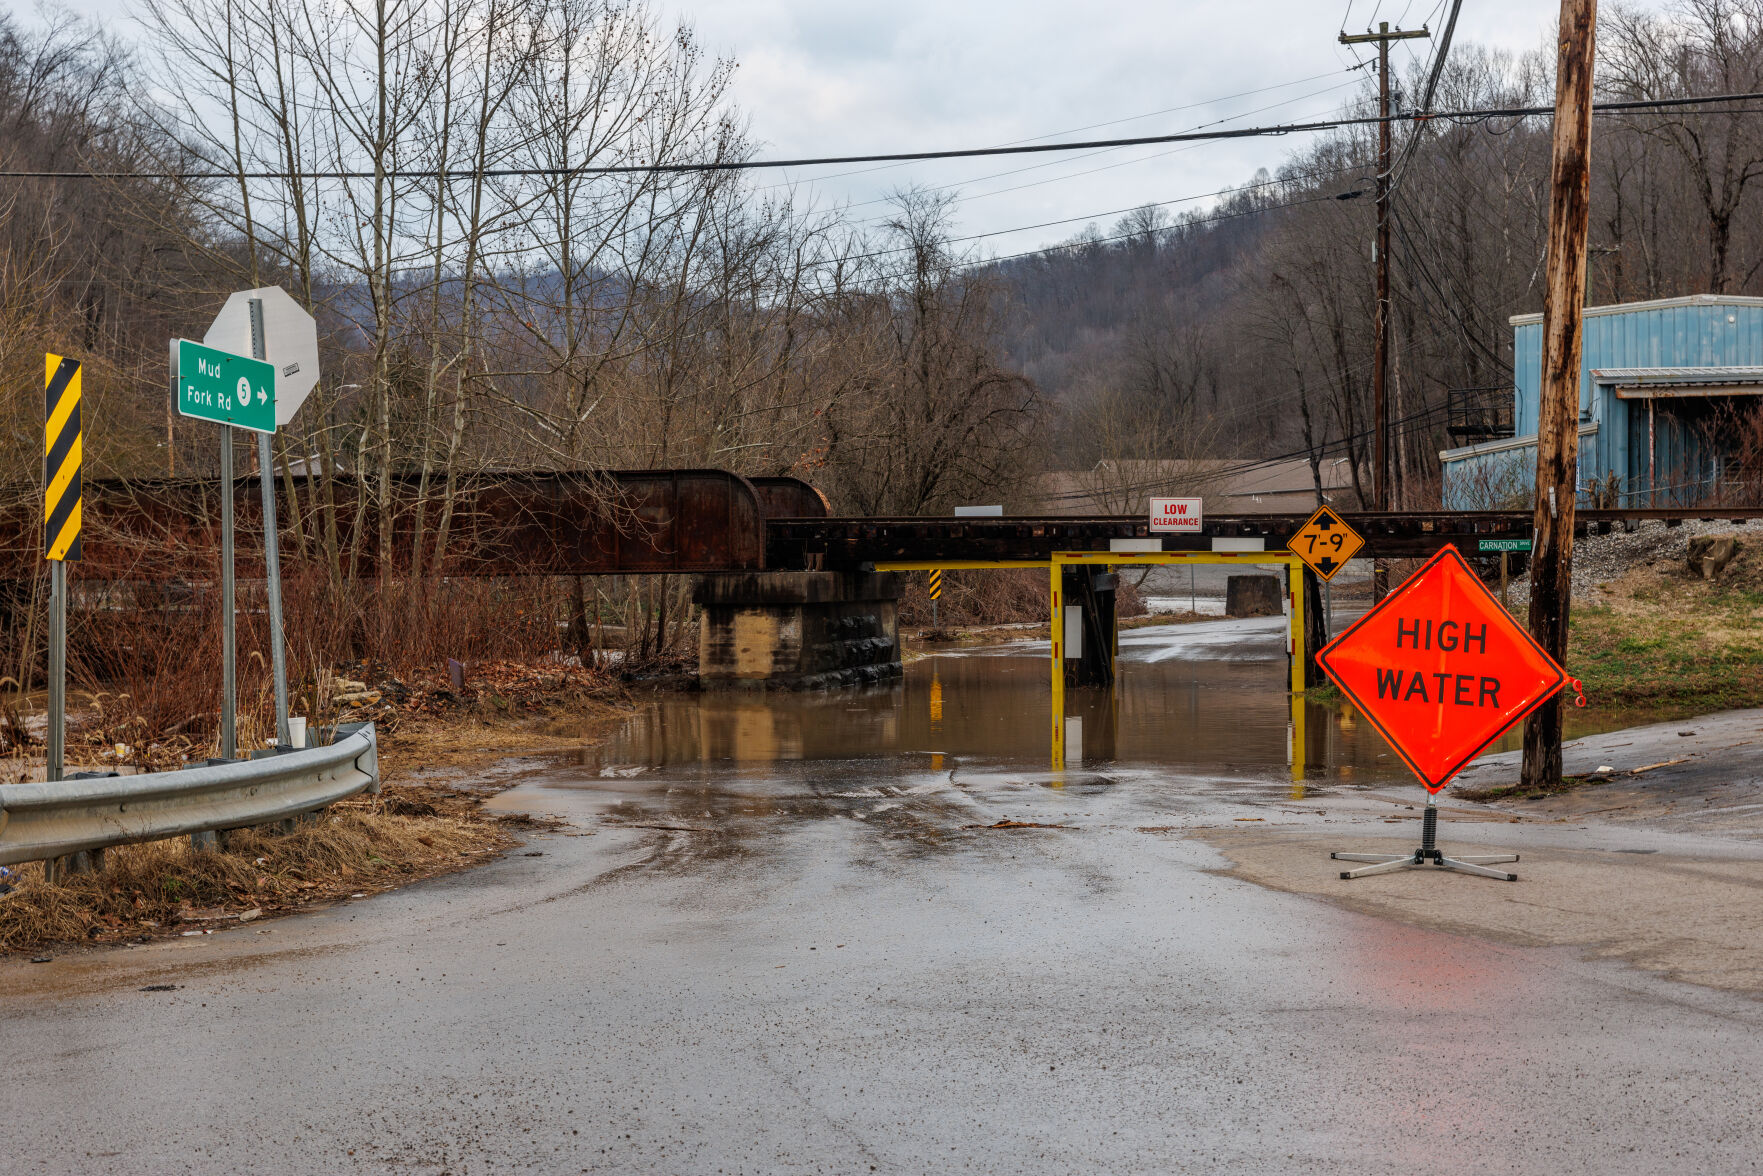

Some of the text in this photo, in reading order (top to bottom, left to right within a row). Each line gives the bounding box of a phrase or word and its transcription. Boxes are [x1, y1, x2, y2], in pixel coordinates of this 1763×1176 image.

[198, 357, 221, 379] Mud
[187, 385, 231, 411] Fork Rd
[241, 383, 247, 399] 5
[1164, 504, 1187, 515] LOW
[1153, 518, 1199, 526] CLEARANCE
[1480, 541, 1518, 550] CARNATION
[1396, 618, 1487, 654] HIGH
[1376, 668, 1501, 709] WATER
